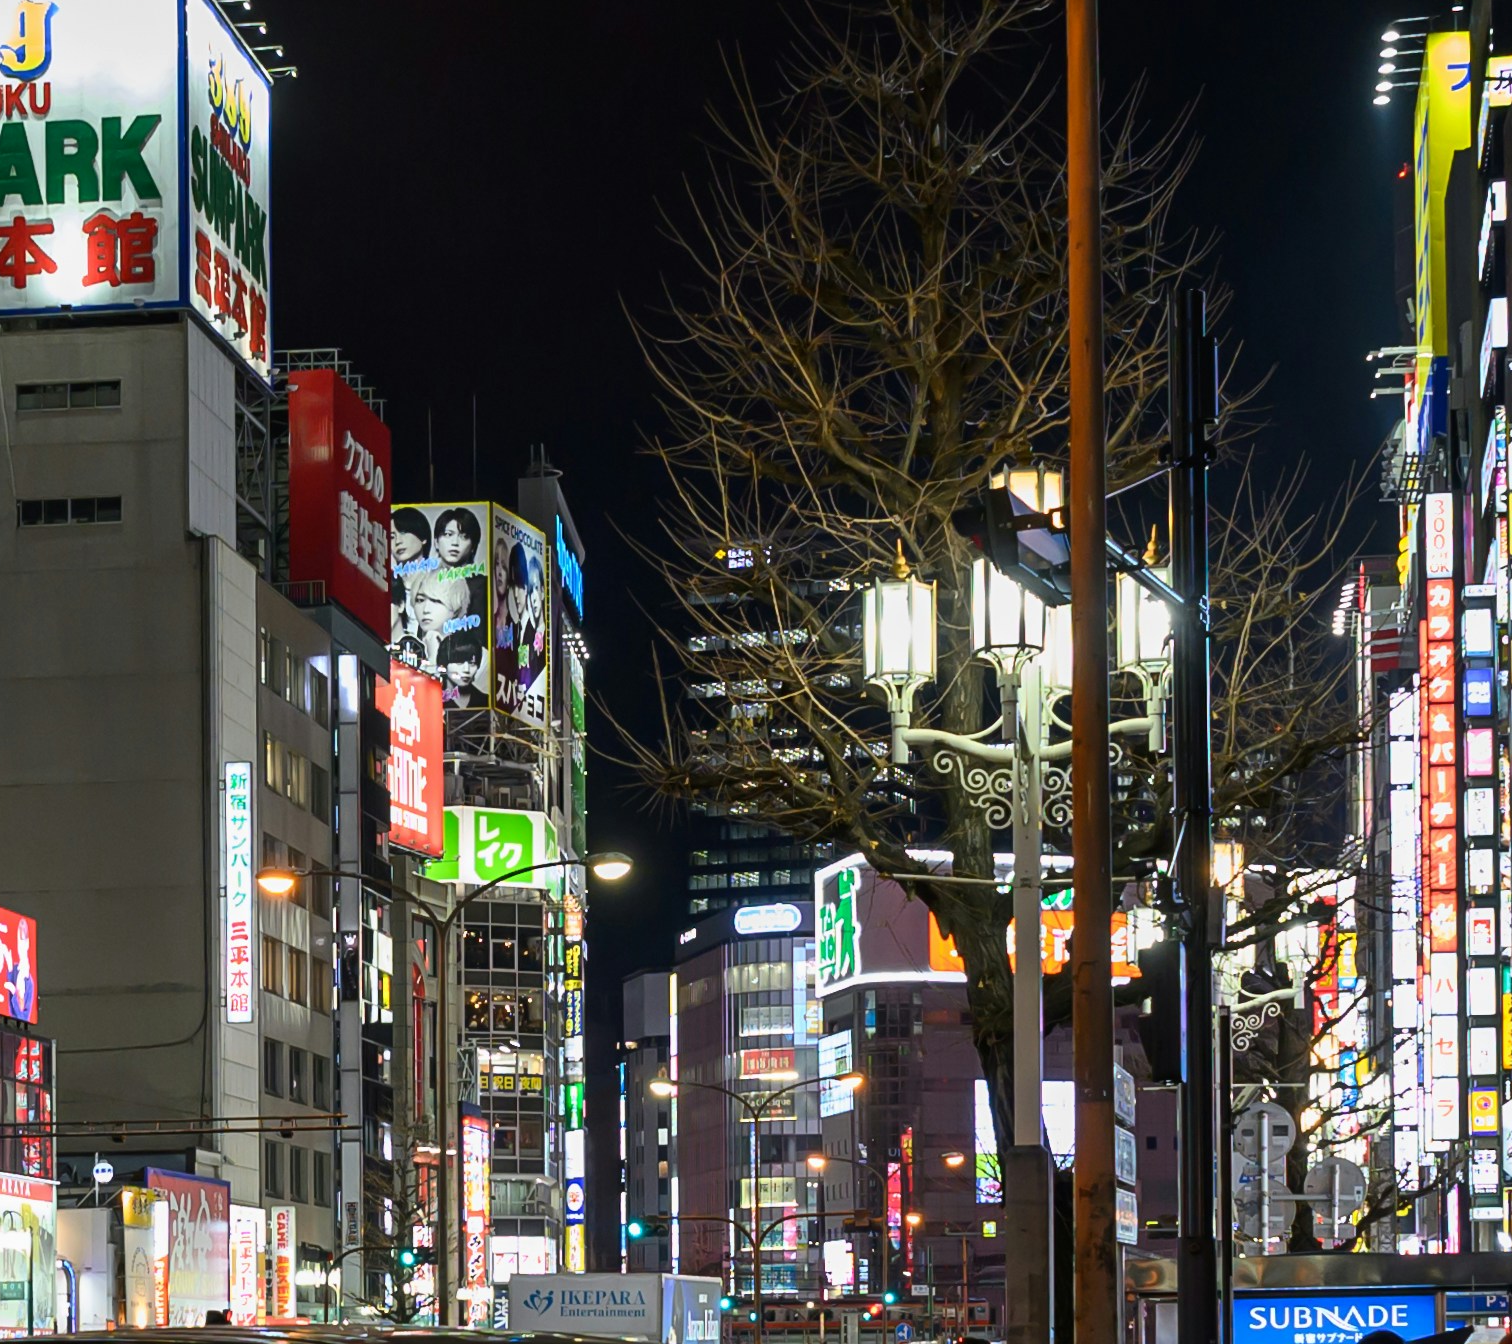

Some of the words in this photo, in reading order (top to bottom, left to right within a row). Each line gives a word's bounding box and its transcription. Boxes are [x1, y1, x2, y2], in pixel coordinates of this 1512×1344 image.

[190, 123, 269, 295] SUNPARK
[342, 429, 387, 504] クスリの
[510, 524, 544, 557] CHOCOLATE
[227, 771, 250, 906] 新宿サンパーク
[229, 919, 250, 1015] 三平本館
[492, 1075, 515, 1091] 祝日
[276, 1212, 286, 1250] GAME
[238, 1231, 254, 1306] 三平ストア
[560, 1289, 646, 1306] IKEPARA
[560, 1306, 647, 1318] Entertainment
[1486, 1296, 1497, 1307] P
[1248, 1304, 1409, 1332] SUBNADE
